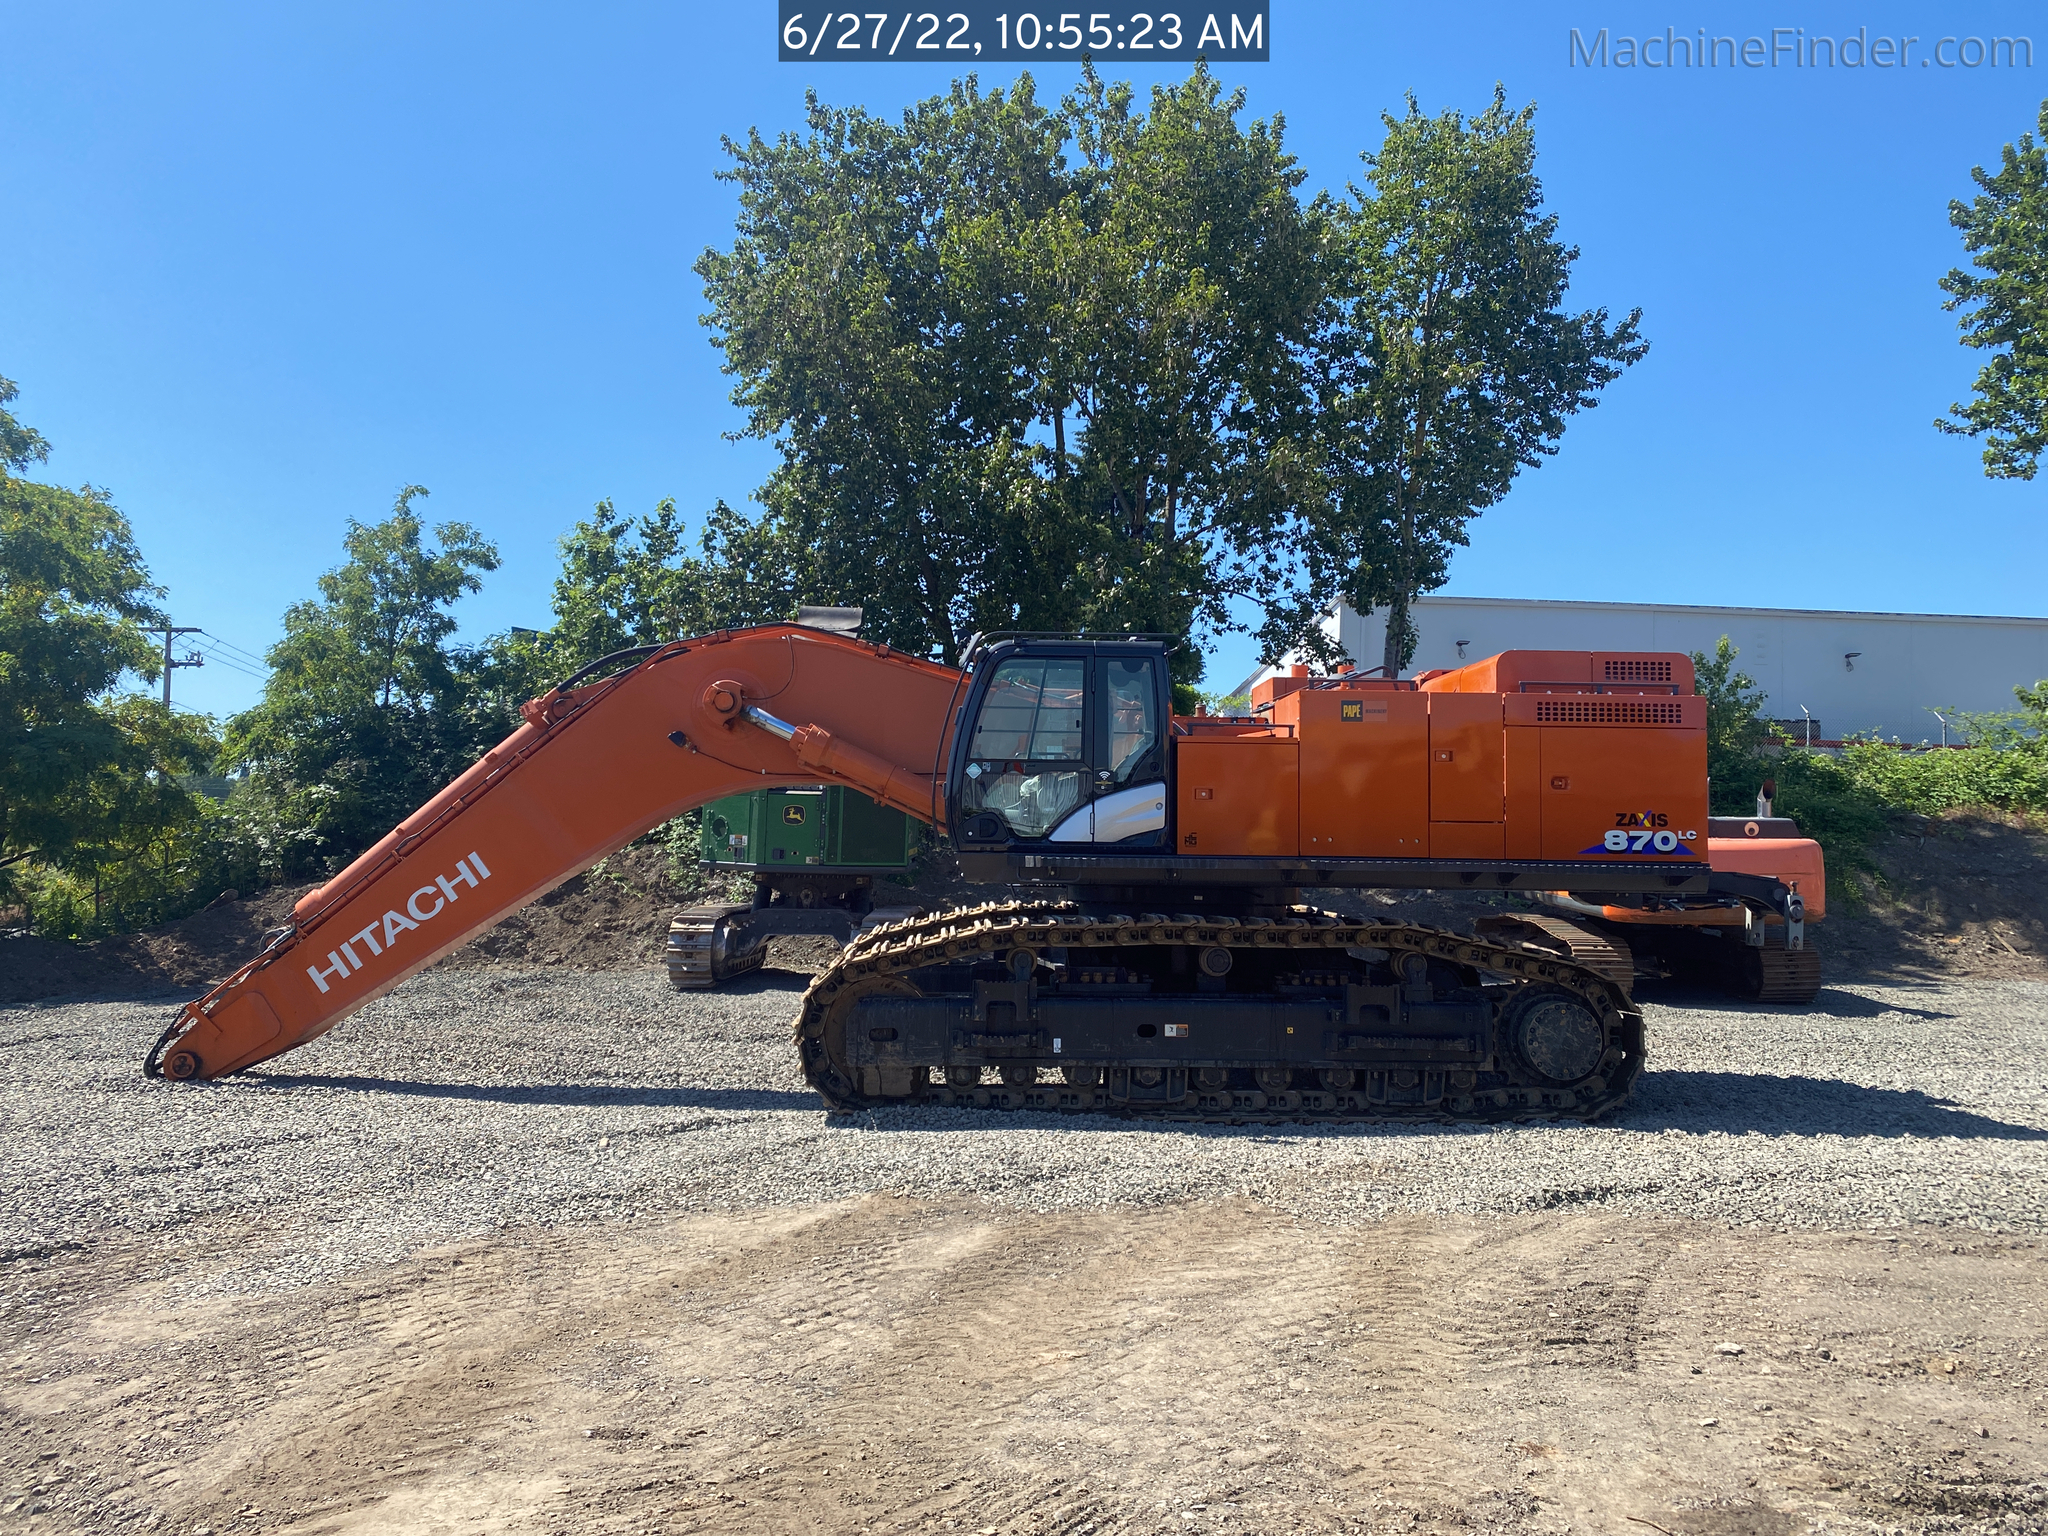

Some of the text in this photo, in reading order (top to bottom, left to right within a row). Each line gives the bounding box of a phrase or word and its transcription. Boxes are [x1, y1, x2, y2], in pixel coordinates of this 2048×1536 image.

[1615, 810, 1668, 827] ZAXIS
[1604, 830, 1678, 853] 870
[306, 851, 491, 994] HITACHI
